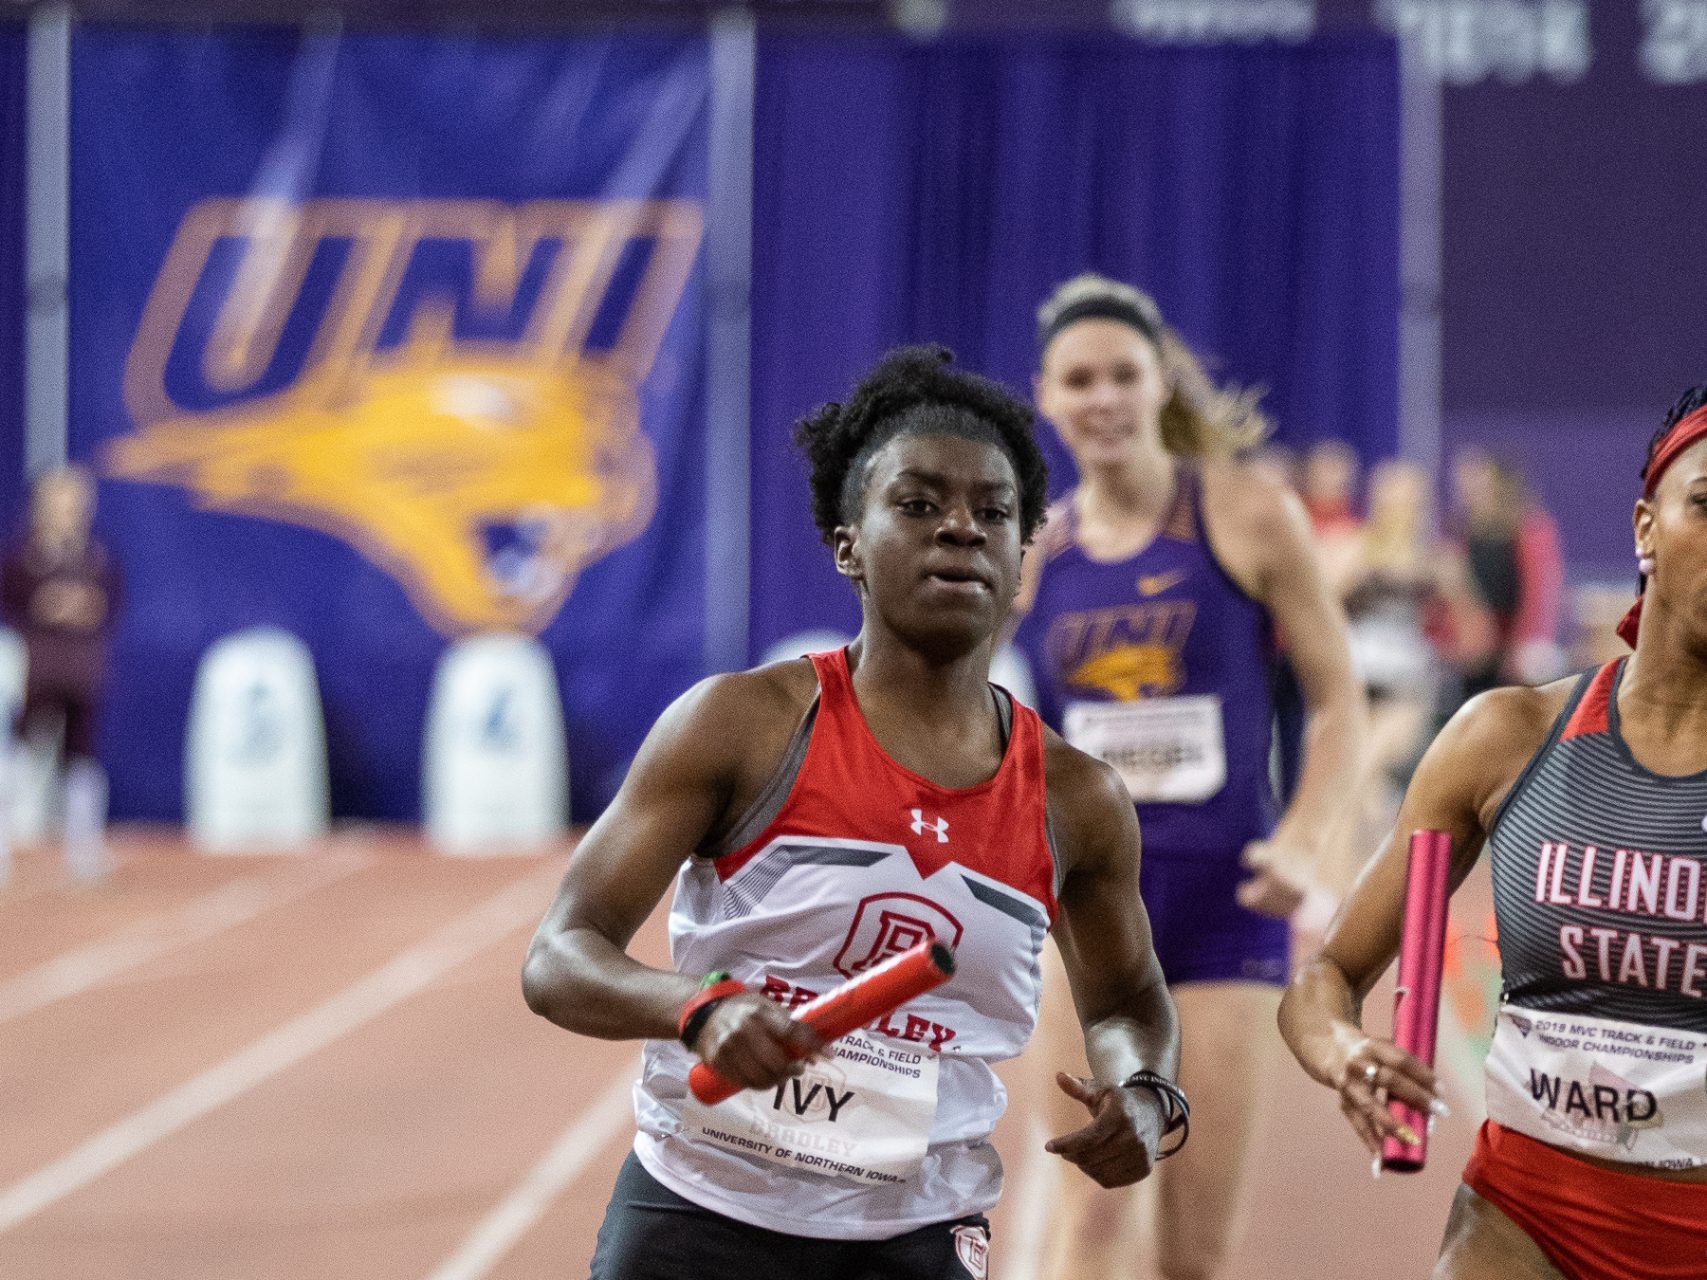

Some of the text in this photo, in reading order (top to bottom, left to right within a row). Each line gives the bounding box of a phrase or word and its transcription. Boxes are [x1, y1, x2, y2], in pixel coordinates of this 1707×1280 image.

[123, 197, 702, 428] UNI
[1535, 842, 1707, 924] ILLINO
[1559, 925, 1707, 998] STATE
[759, 974, 956, 1053] BRLEY
[1569, 1024, 1598, 1037] MVC
[1601, 1028, 1643, 1045] TRACK
[1645, 1035, 1655, 1045] &
[1658, 1037, 1697, 1051] FIELD
[833, 1046, 921, 1079] AMPIONSHIPS
[888, 1050, 921, 1065] FIELD
[1538, 1033, 1695, 1064] INDOOR CHAMPIONSHIPS
[773, 1078, 856, 1123] IVY
[1530, 1067, 1658, 1123] WARD
[702, 1126, 773, 1155] UNIVERSITY
[775, 1147, 793, 1159] OF
[794, 1151, 866, 1177] NORTHERN
